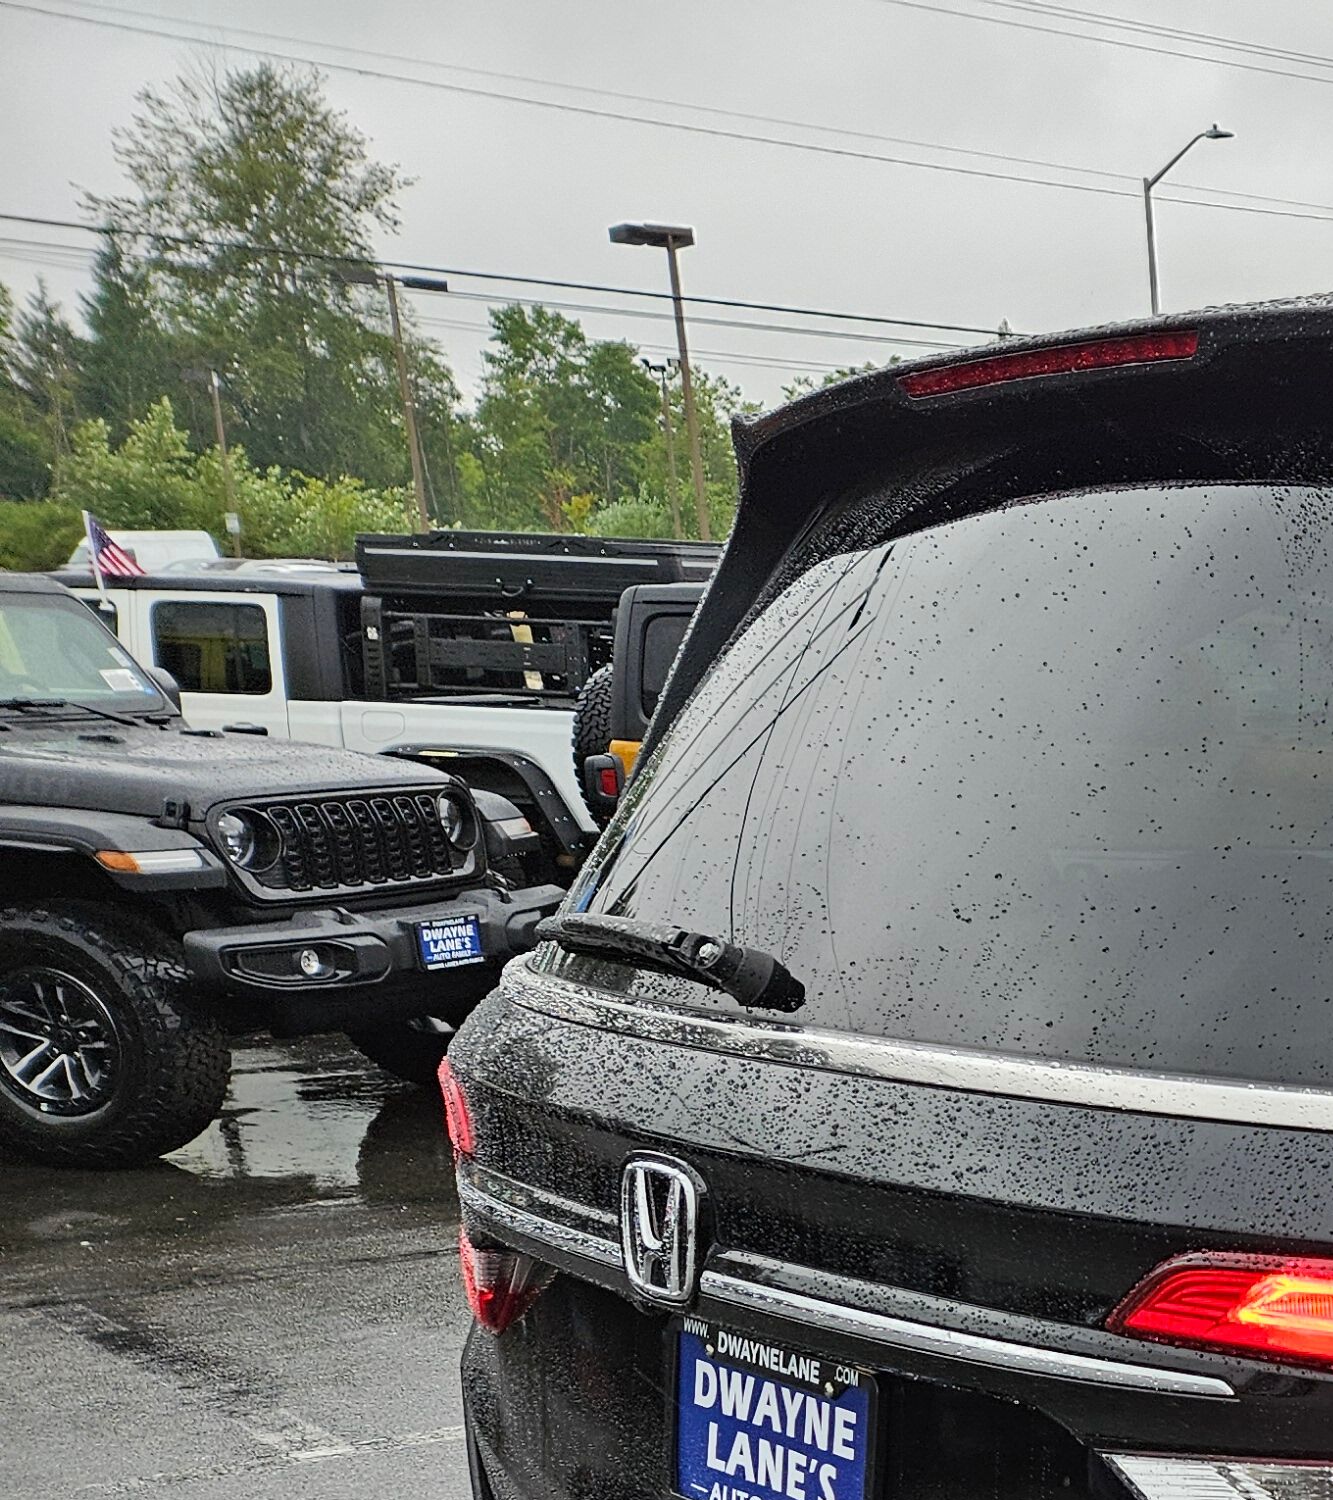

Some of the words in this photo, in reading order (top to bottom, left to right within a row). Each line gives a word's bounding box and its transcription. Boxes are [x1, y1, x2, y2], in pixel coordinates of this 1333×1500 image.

[422, 924, 475, 942] DWAYNE
[429, 937, 471, 953] LANE'S
[717, 1331, 820, 1384] DWAYNELANE
[834, 1365, 859, 1387] .COM
[693, 1358, 857, 1461] DWAYNE
